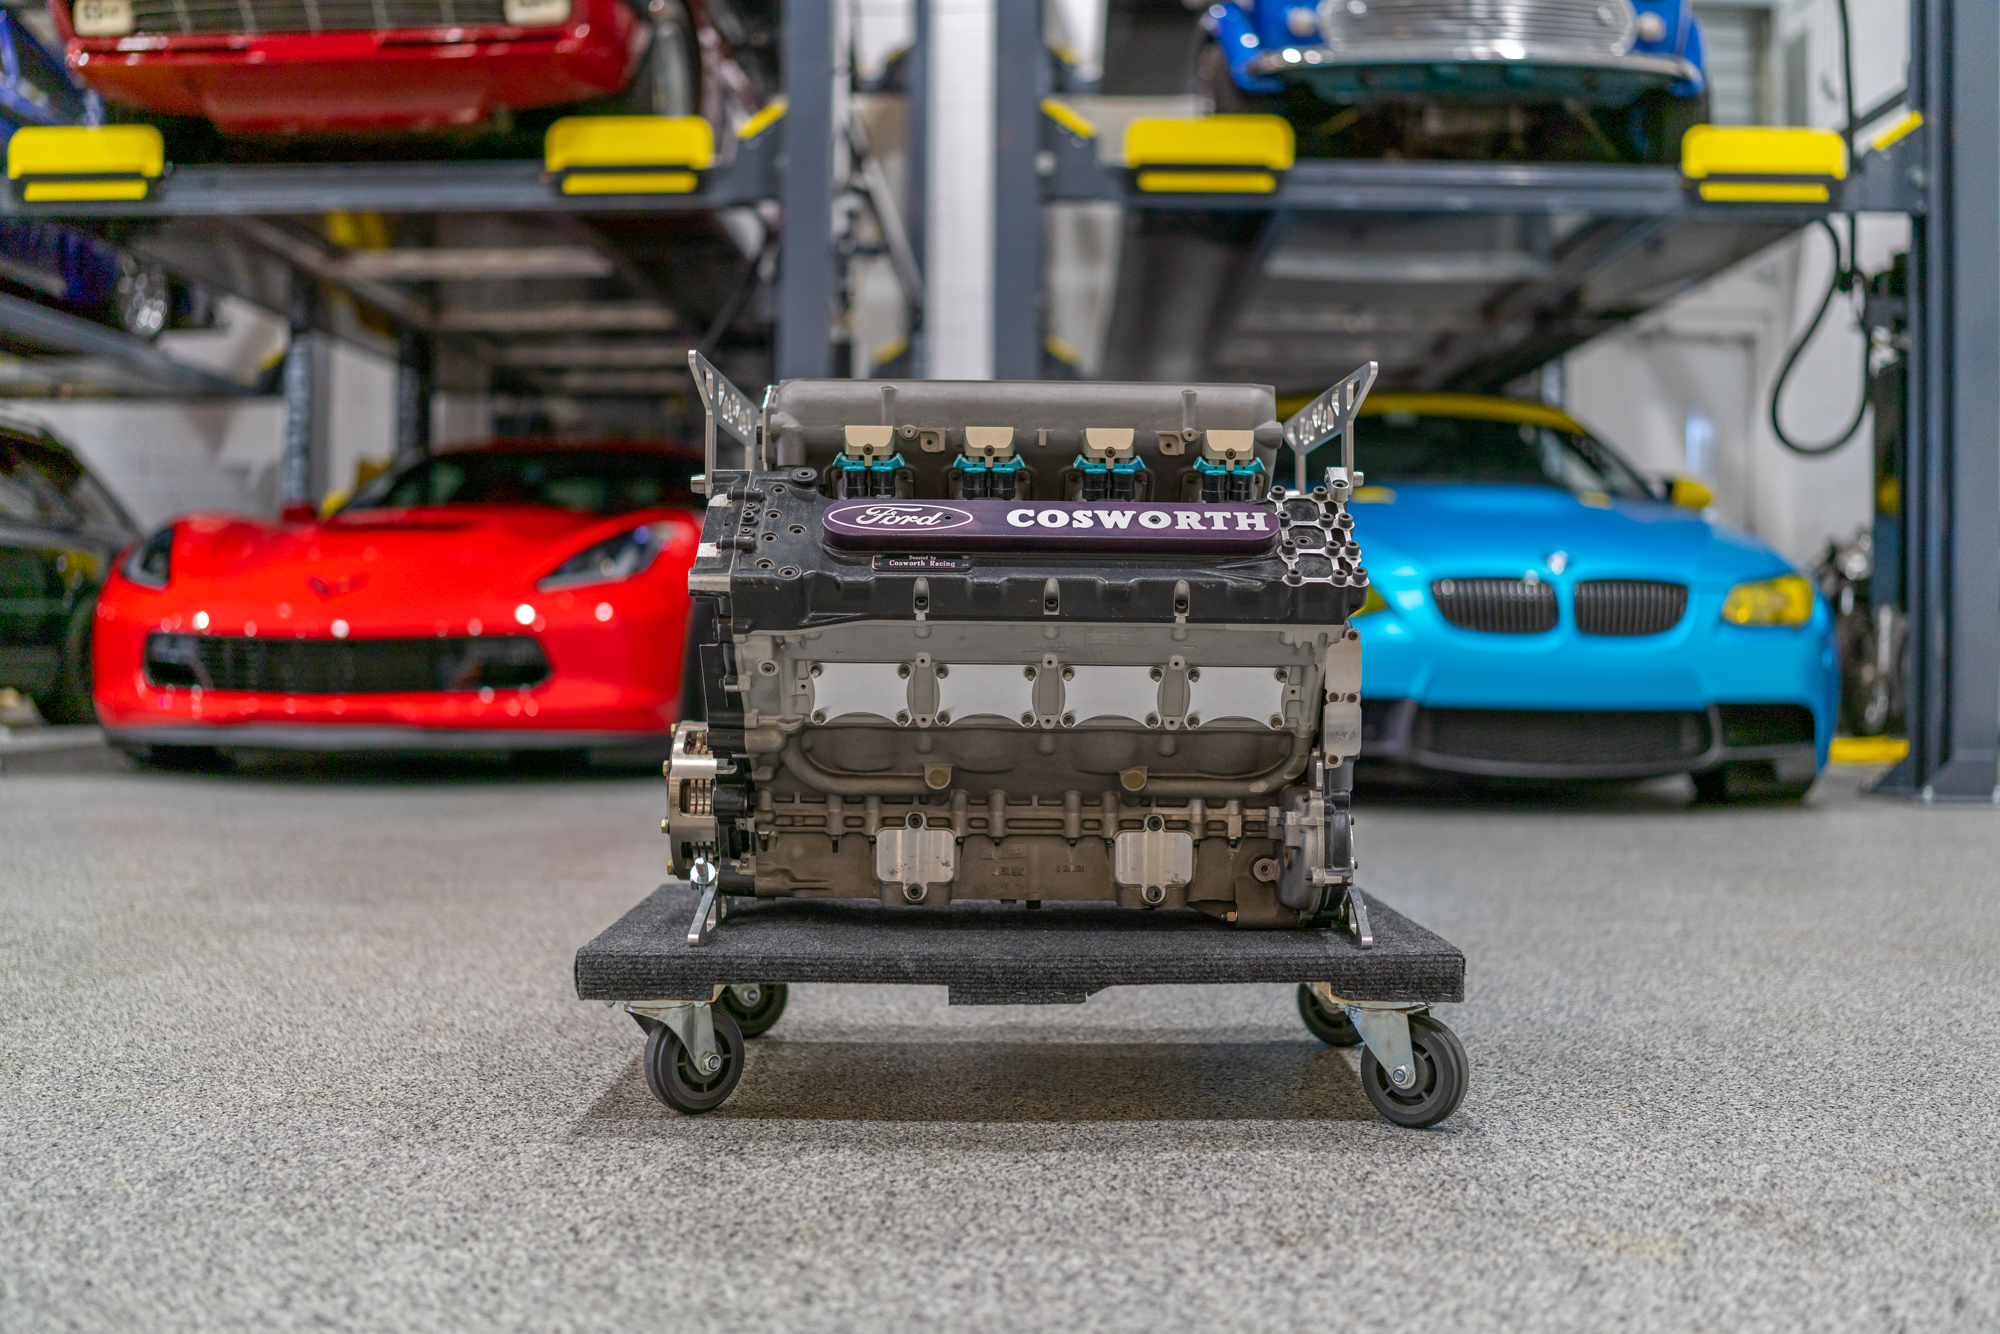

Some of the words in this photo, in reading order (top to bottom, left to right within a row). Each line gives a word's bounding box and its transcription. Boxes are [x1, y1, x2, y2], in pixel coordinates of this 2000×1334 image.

[856, 506, 941, 526] Ford
[1006, 508, 1270, 532] COSWORTH
[930, 560, 956, 568] Racing
